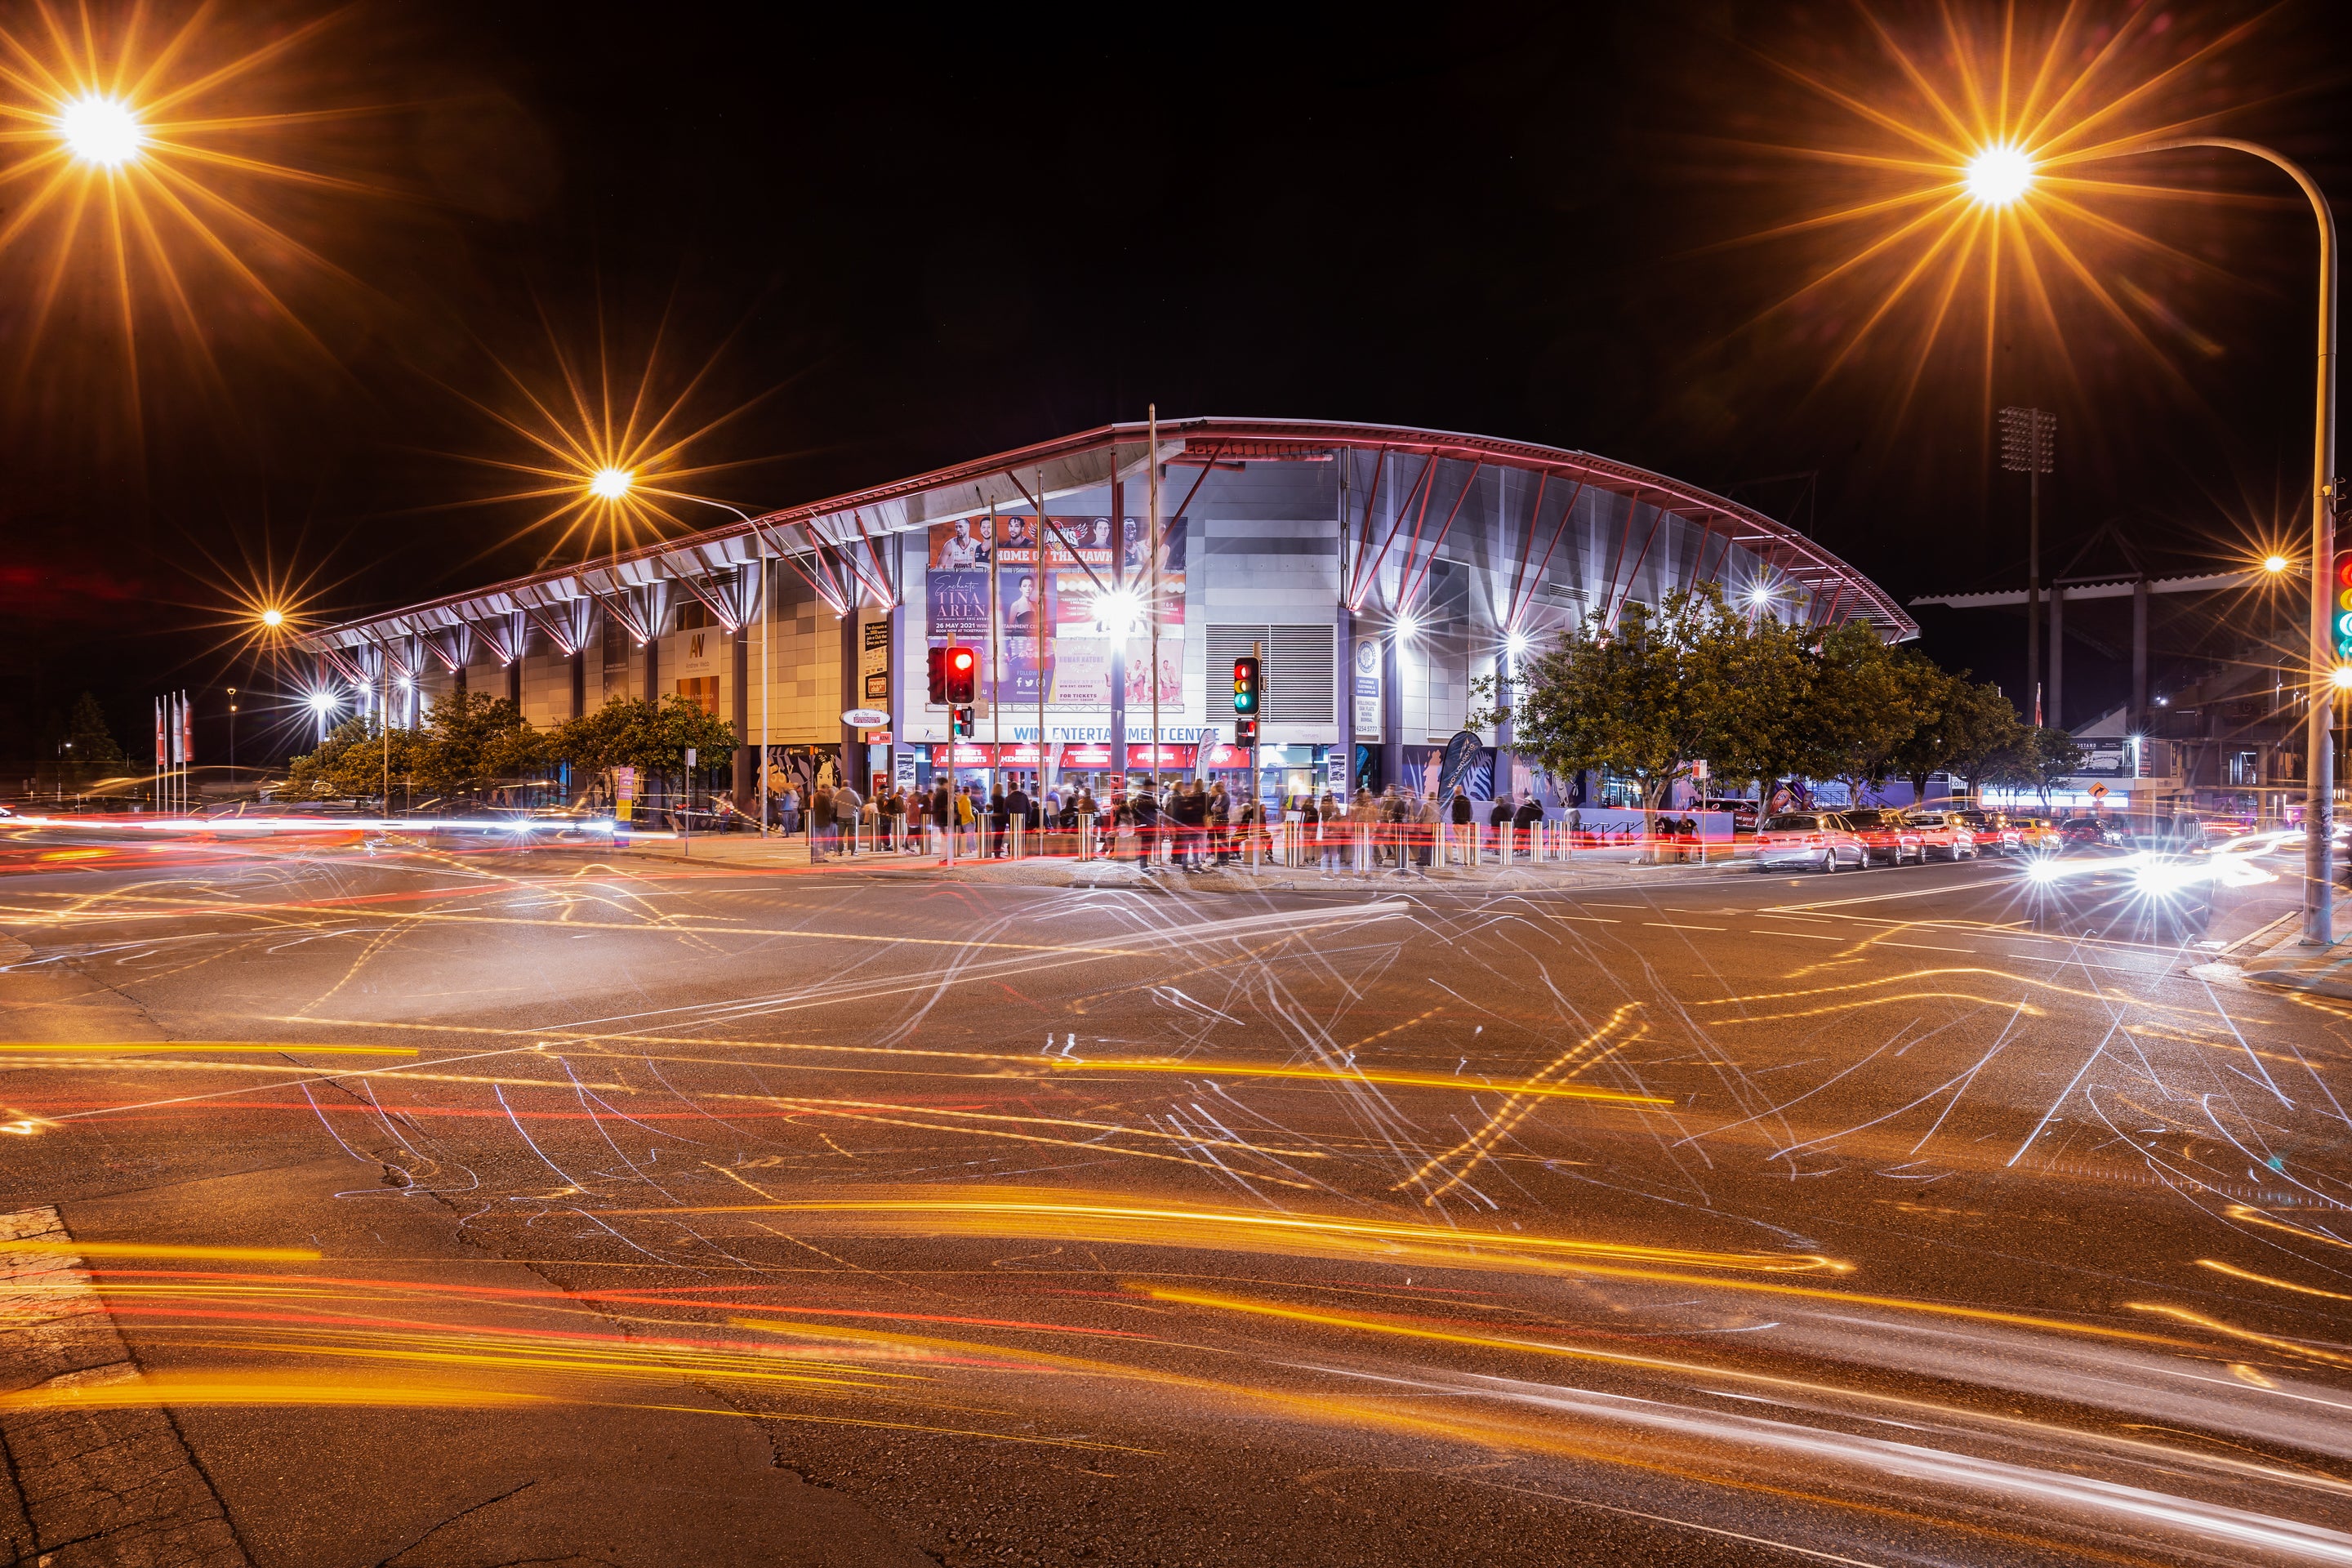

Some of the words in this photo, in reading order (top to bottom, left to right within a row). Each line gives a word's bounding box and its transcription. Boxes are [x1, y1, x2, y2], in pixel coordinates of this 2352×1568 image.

[998, 550, 1030, 561] HOME
[1050, 550, 1072, 561] THE
[1078, 550, 1112, 562] HAWK
[937, 592, 980, 604] TINA
[938, 604, 990, 617] AREN
[1013, 727, 1045, 740] WIN
[1052, 728, 1166, 741] ENTERTAMENT
[1169, 728, 1220, 741] CENTE
